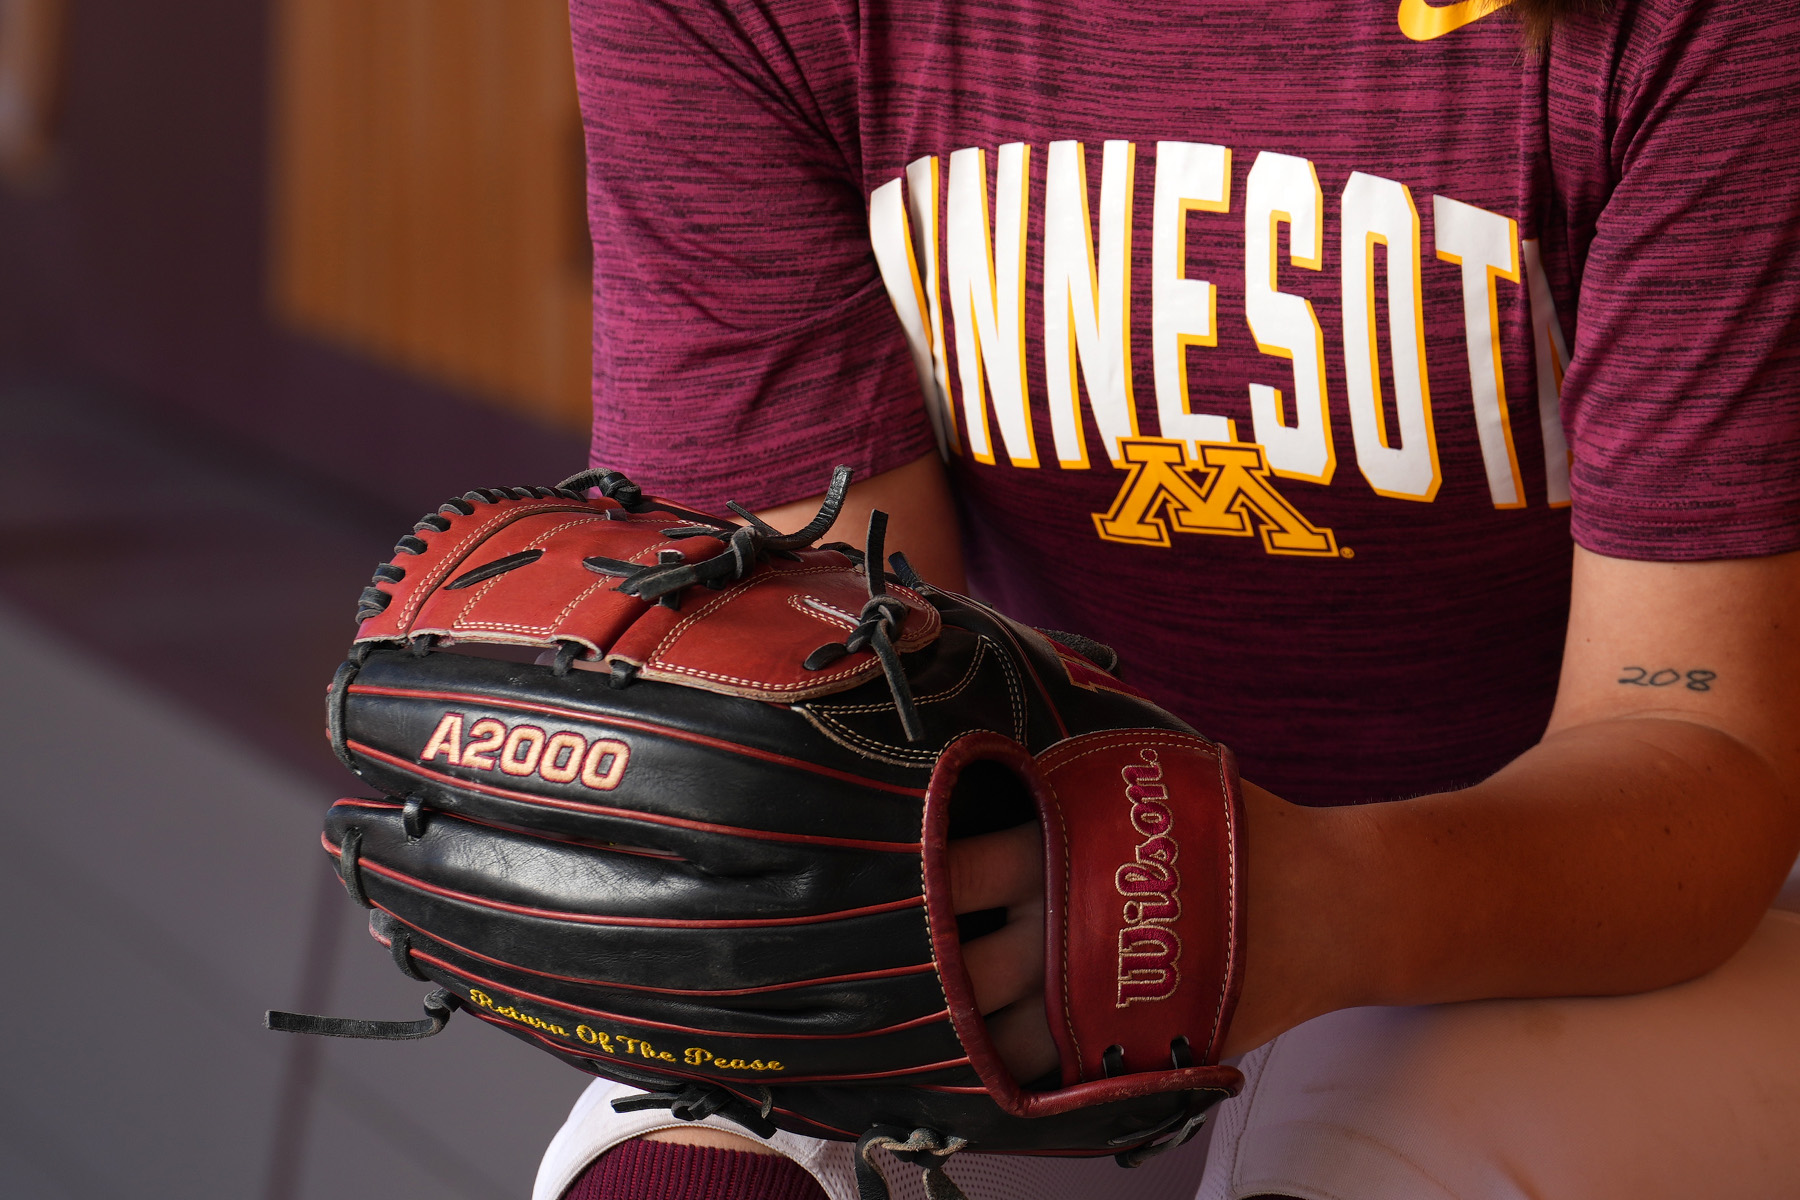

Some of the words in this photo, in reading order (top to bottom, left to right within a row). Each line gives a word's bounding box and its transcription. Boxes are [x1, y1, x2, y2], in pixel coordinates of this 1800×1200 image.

[869, 139, 1572, 509] INNESOTA
[1091, 436, 1340, 557] M
[1618, 666, 1717, 691] 208
[420, 711, 632, 792] A2000
[1115, 760, 1182, 1008] Wilson
[469, 988, 570, 1038] Return
[576, 1024, 615, 1054] Of
[615, 1034, 677, 1064] The
[684, 1047, 785, 1071] Pease
